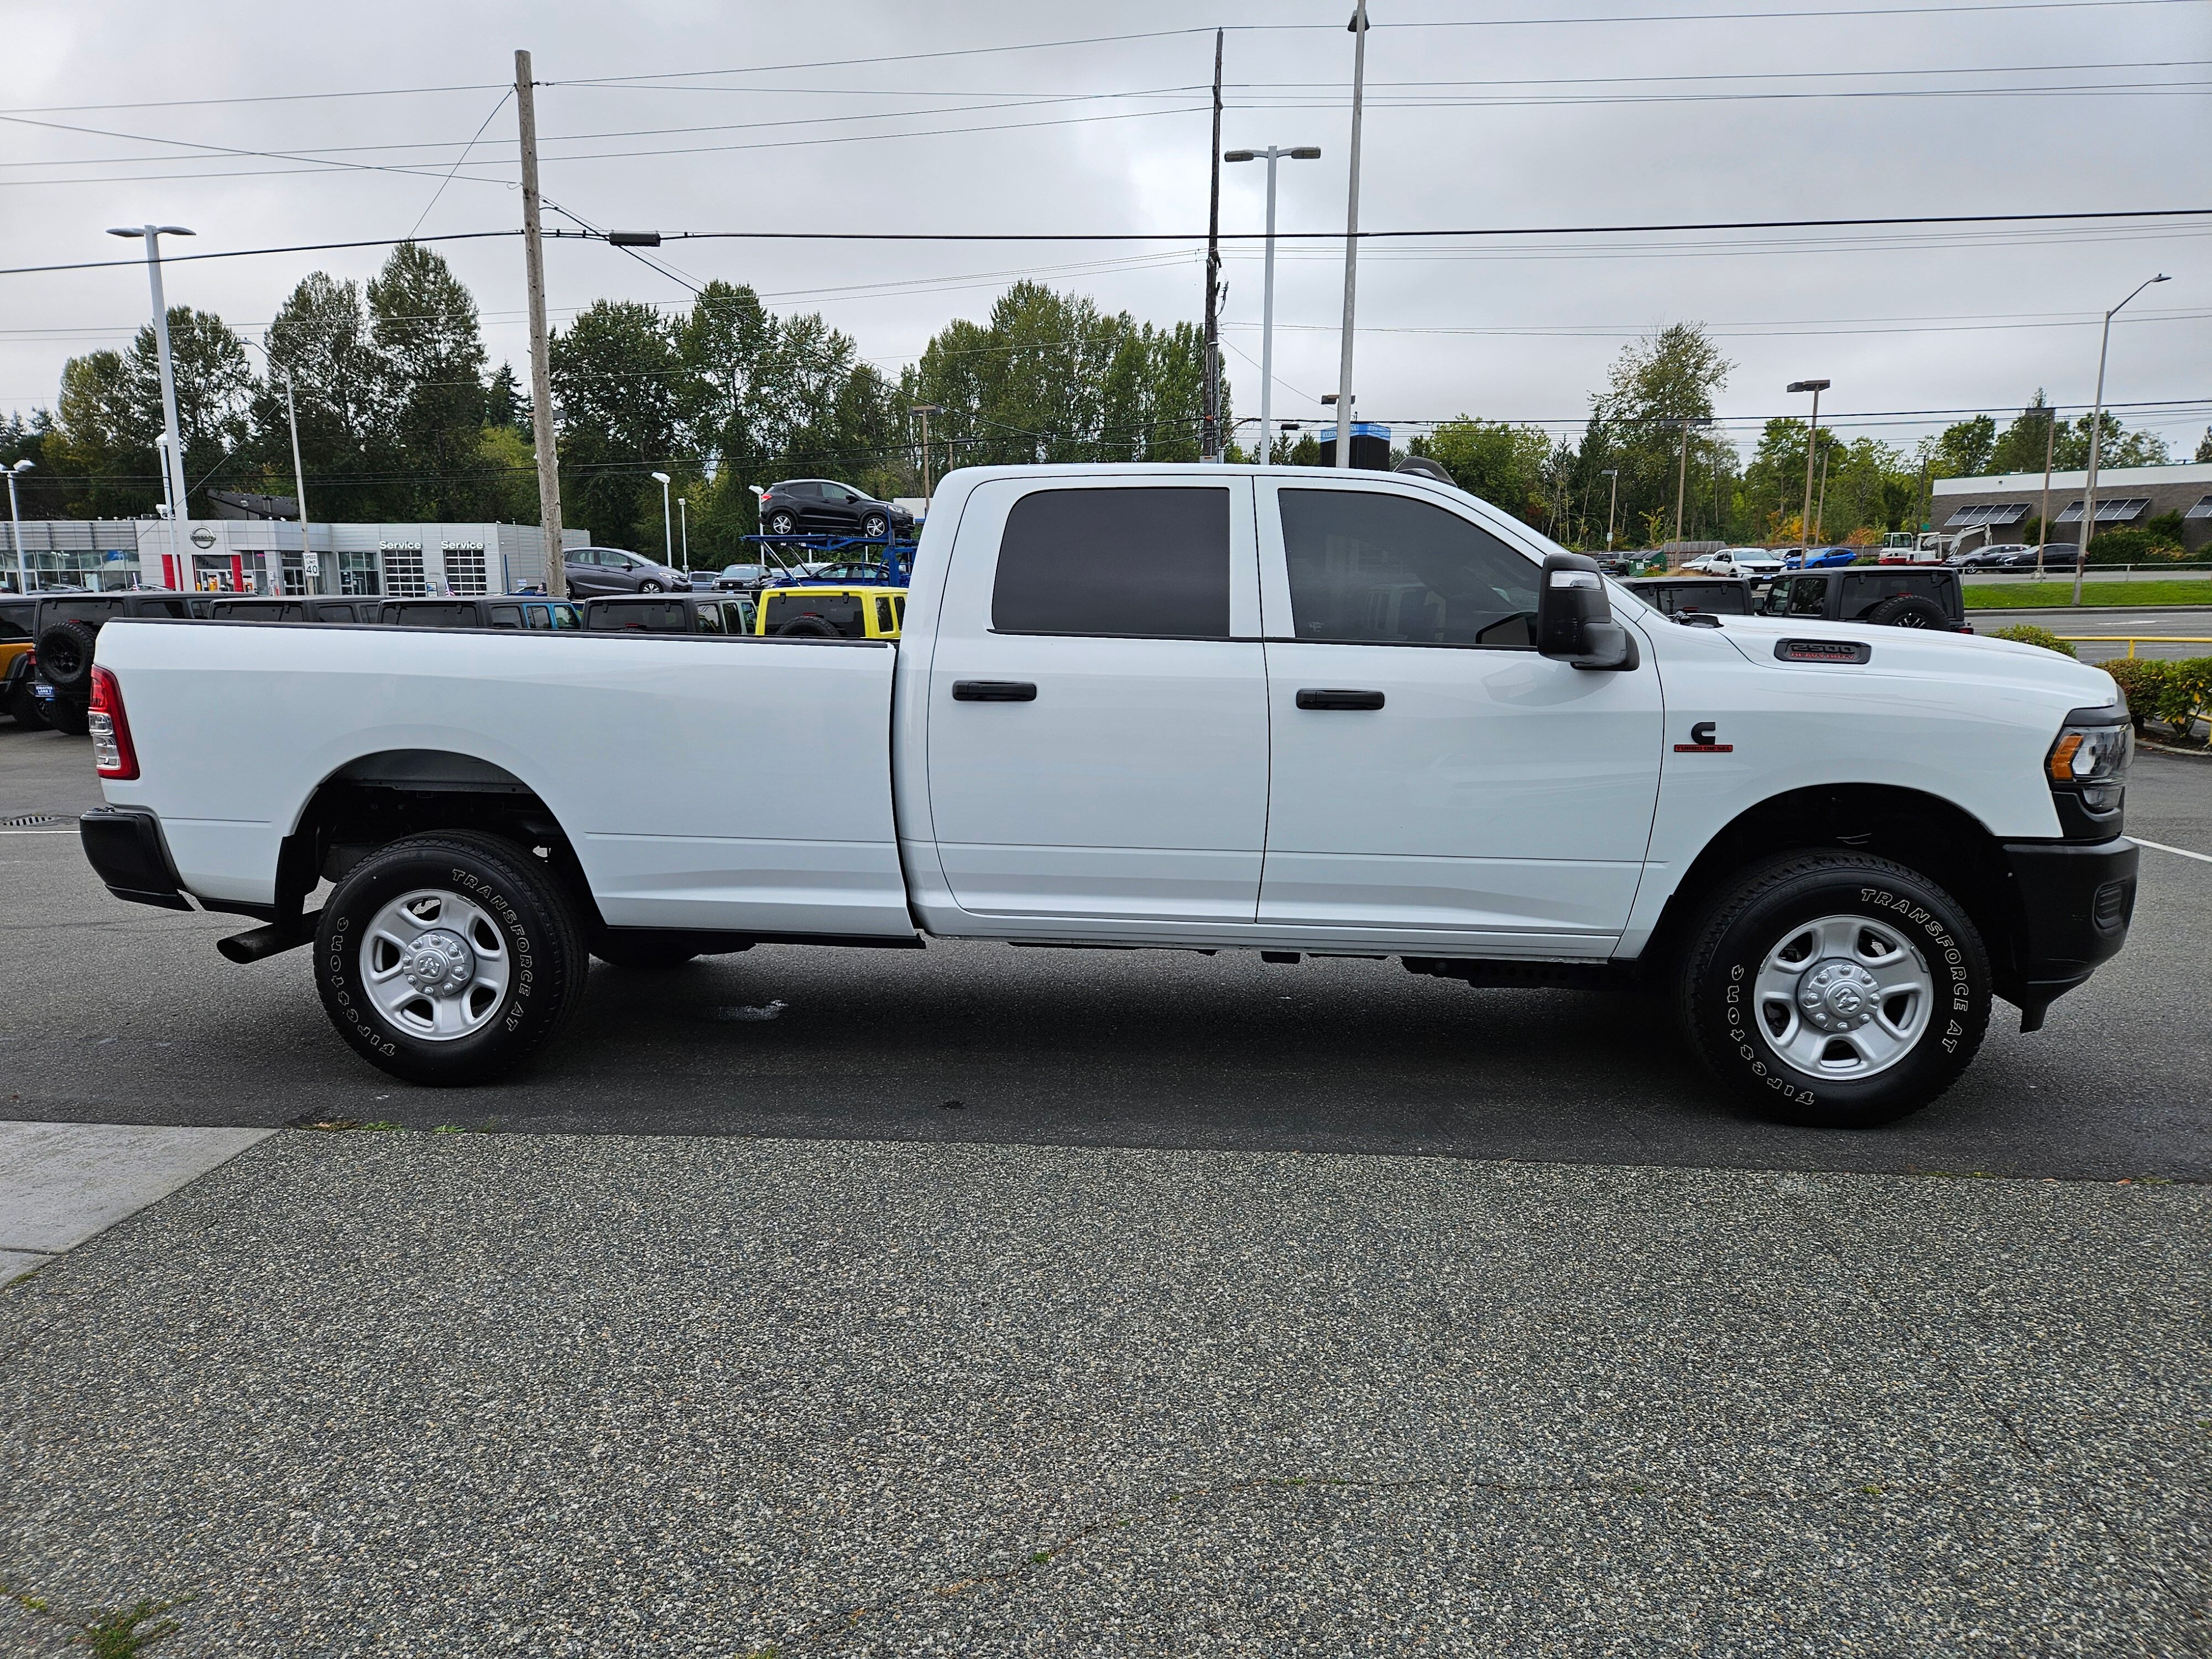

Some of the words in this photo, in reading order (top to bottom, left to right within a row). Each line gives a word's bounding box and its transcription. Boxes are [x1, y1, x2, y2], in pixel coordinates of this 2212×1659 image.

[306, 565, 317, 573] 40
[379, 541, 421, 549] Service
[441, 541, 483, 549] Service
[1790, 644, 1855, 654] 2500
[330, 917, 396, 1057] Firestone
[452, 869, 533, 997] TRANSFORCE
[506, 1001, 524, 1032] AT
[1861, 889, 1969, 1011] TRANSFORCE
[1942, 1019, 1963, 1053] AT
[1728, 964, 1815, 1105] Firestone
